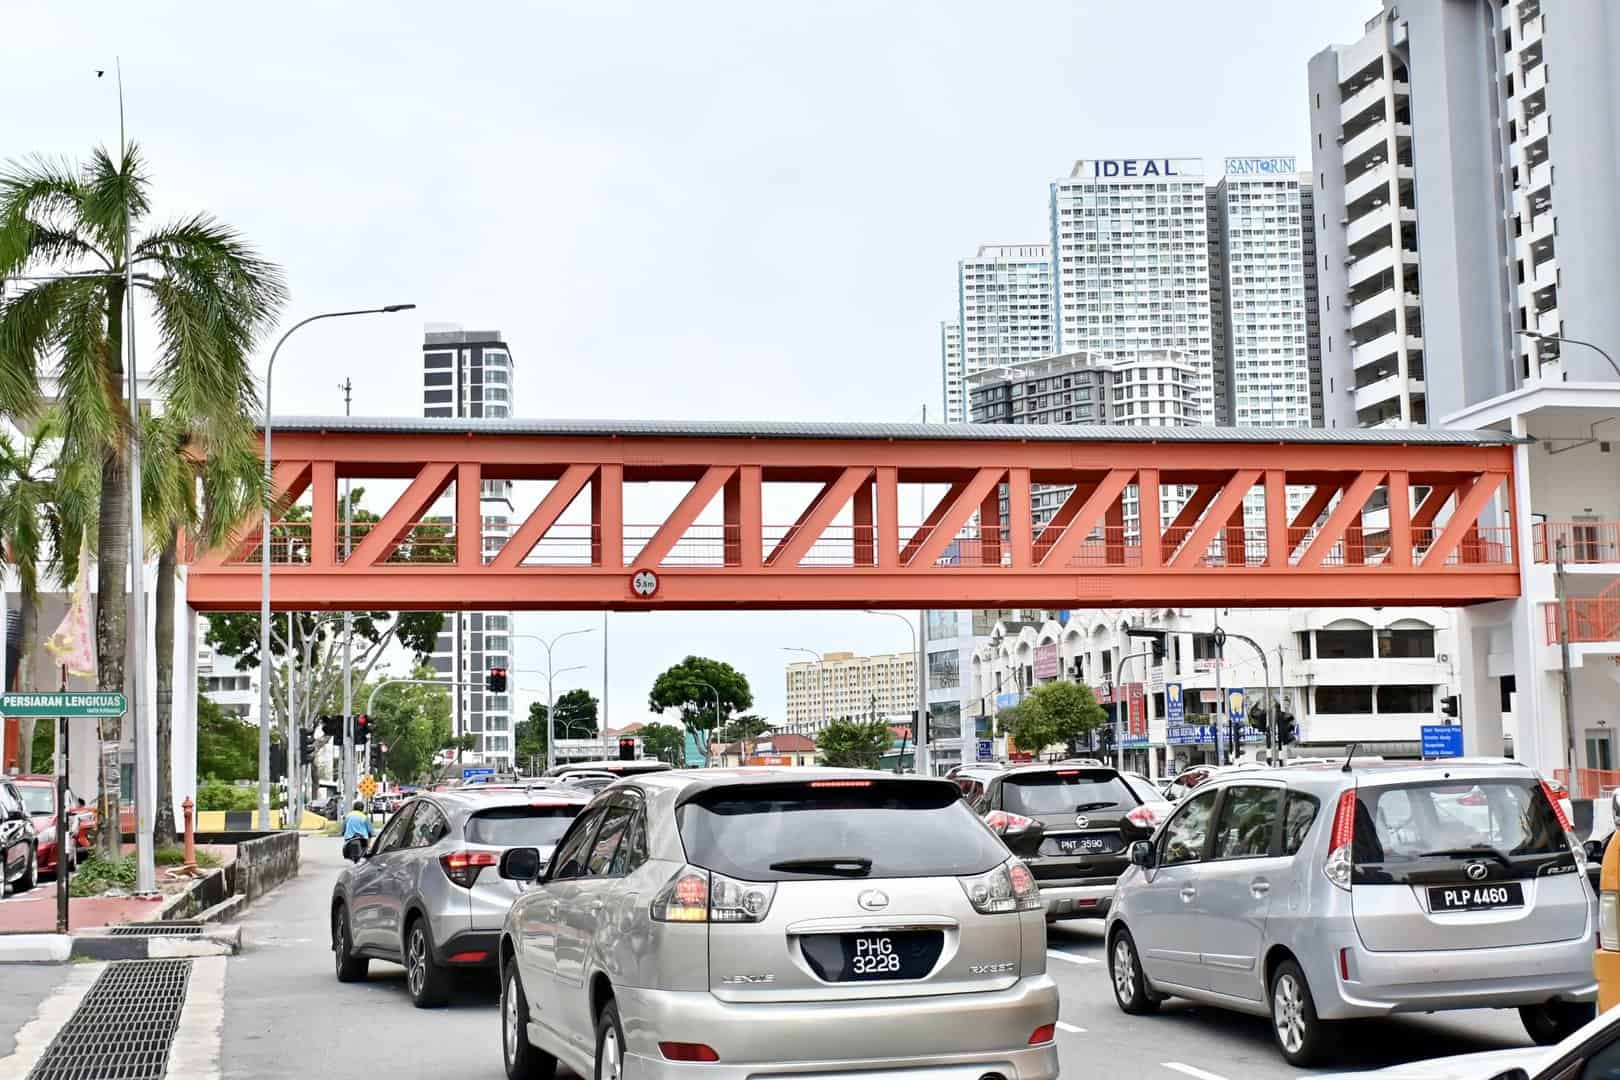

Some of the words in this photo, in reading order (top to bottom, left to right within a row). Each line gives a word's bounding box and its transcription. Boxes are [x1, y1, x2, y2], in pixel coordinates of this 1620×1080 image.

[1094, 159, 1178, 177] IDEAL
[3, 695, 62, 707] PERSIARAN
[65, 695, 120, 707] LENGKUAS
[1061, 840, 1077, 849] PNT
[1080, 839, 1103, 848] 3590
[1444, 889, 1470, 906] PLP
[1473, 887, 1508, 904] 4460
[856, 938, 892, 955] PHG
[853, 954, 899, 973] 3228
